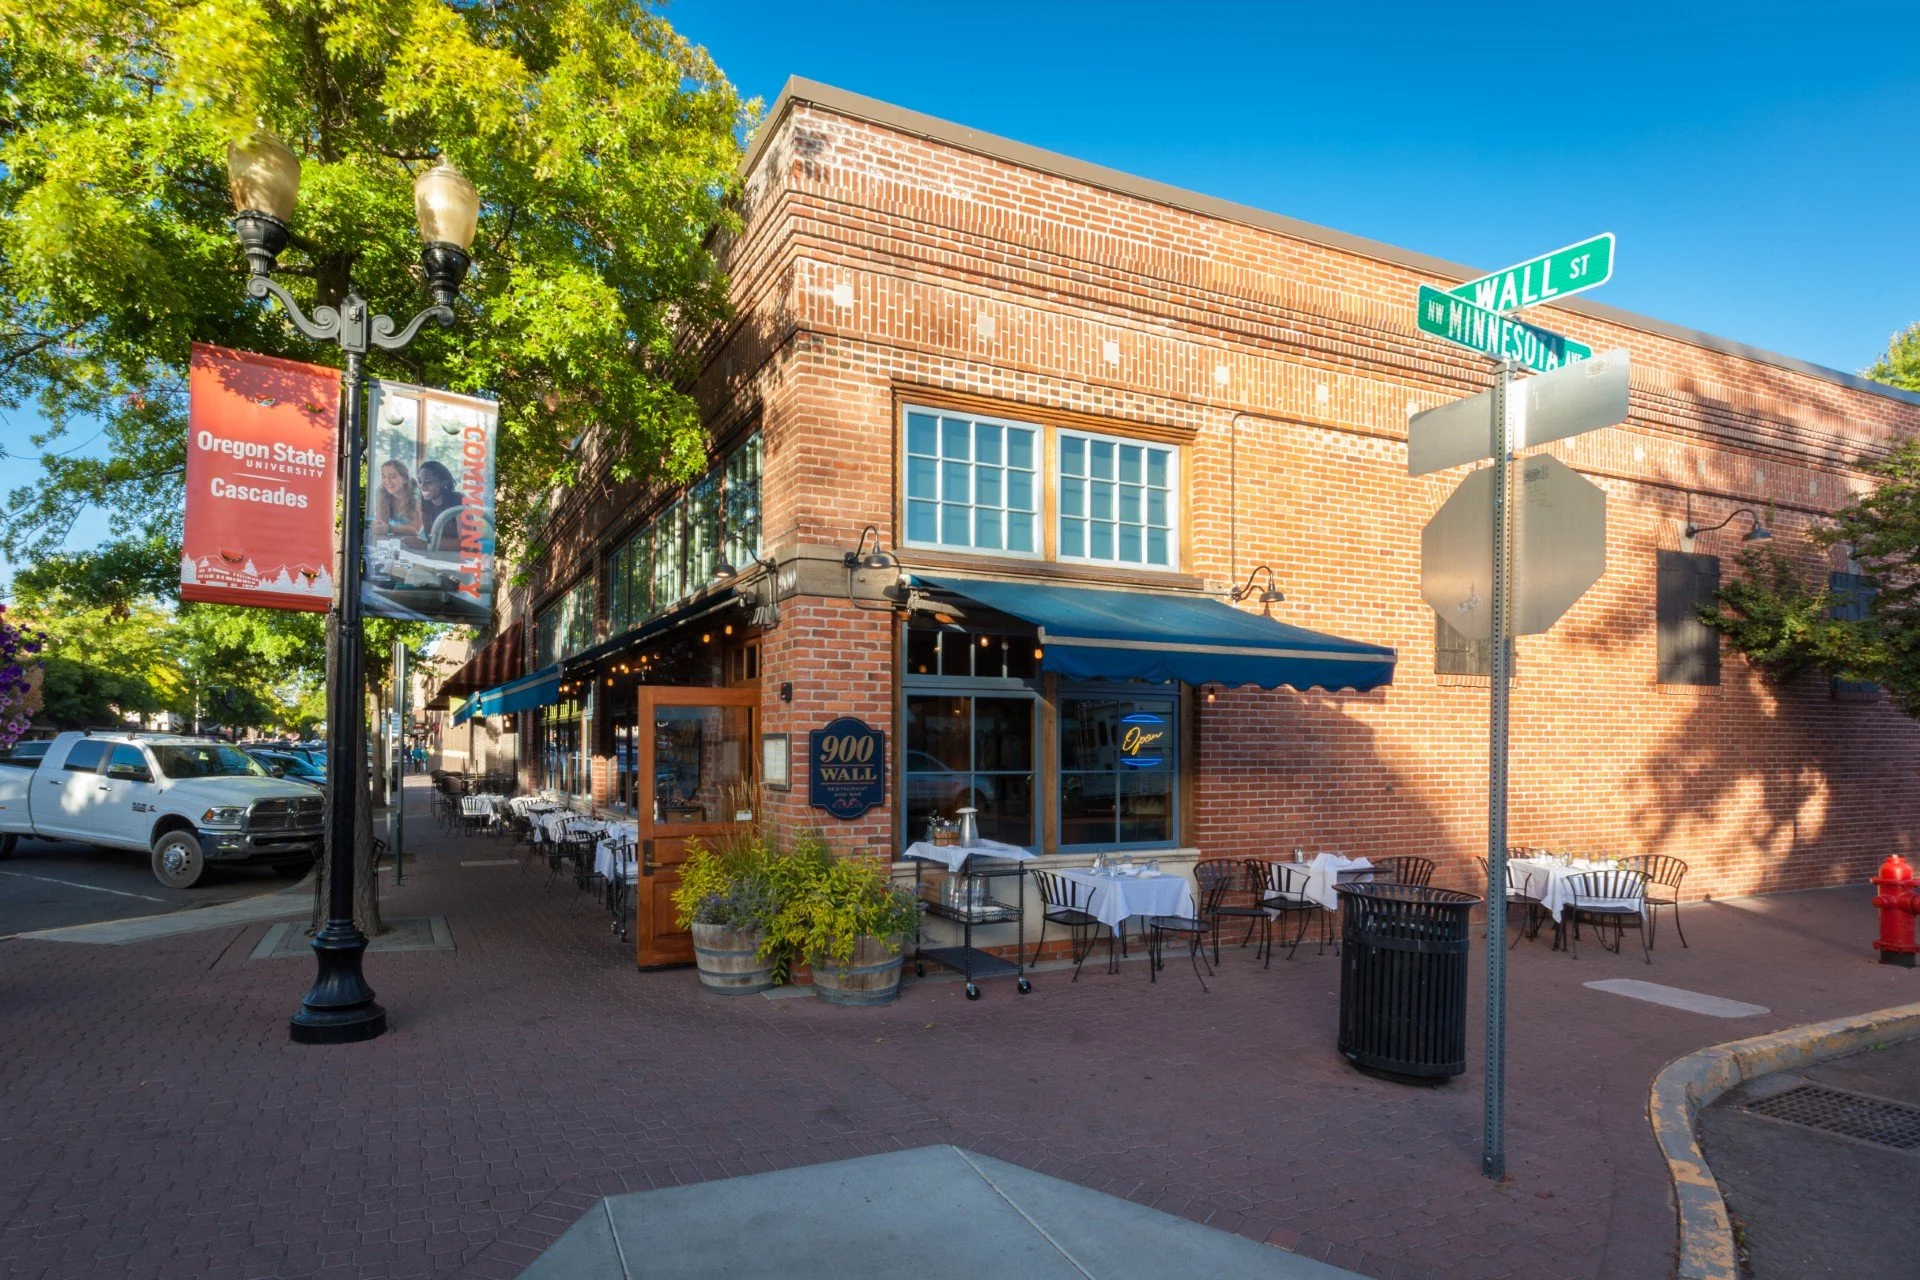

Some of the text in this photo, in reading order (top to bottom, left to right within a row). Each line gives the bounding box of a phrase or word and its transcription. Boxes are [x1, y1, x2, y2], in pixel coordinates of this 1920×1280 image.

[1475, 253, 1590, 313] WALL ST
[1427, 299, 1445, 325] NW
[1448, 300, 1559, 372] MINNESOTA
[197, 430, 326, 468] Oregon State
[246, 460, 324, 479] UNIVERSITY
[210, 477, 308, 509] Cascades
[459, 426, 486, 599] COMMUNITY
[819, 735, 875, 763] 900
[1122, 726, 1163, 756] Open
[819, 767, 877, 782] WALL
